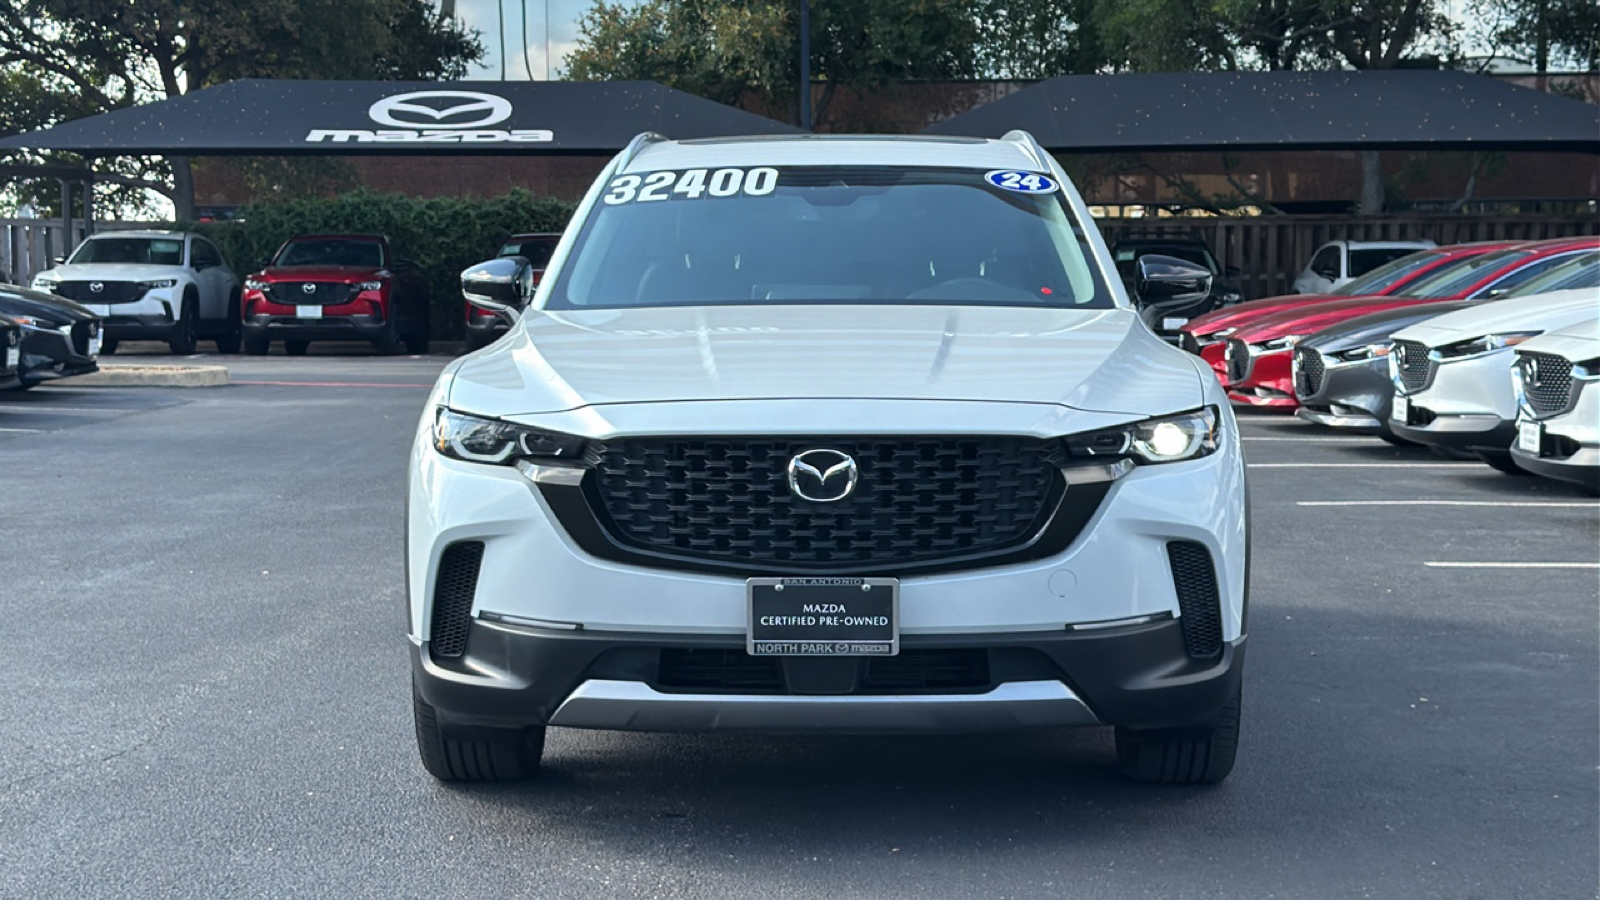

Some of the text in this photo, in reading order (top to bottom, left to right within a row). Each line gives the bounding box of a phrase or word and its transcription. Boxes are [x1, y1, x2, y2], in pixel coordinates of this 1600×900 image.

[305, 129, 554, 142] mazda
[604, 167, 779, 205] 32400
[1000, 173, 1042, 191] 24
[784, 578, 862, 586] SAN ANTONIO
[803, 604, 846, 614] MAZDA
[760, 616, 888, 626] CERTIFIED PRE-OWNED
[757, 643, 797, 653] NORTH
[801, 643, 833, 653] PARK
